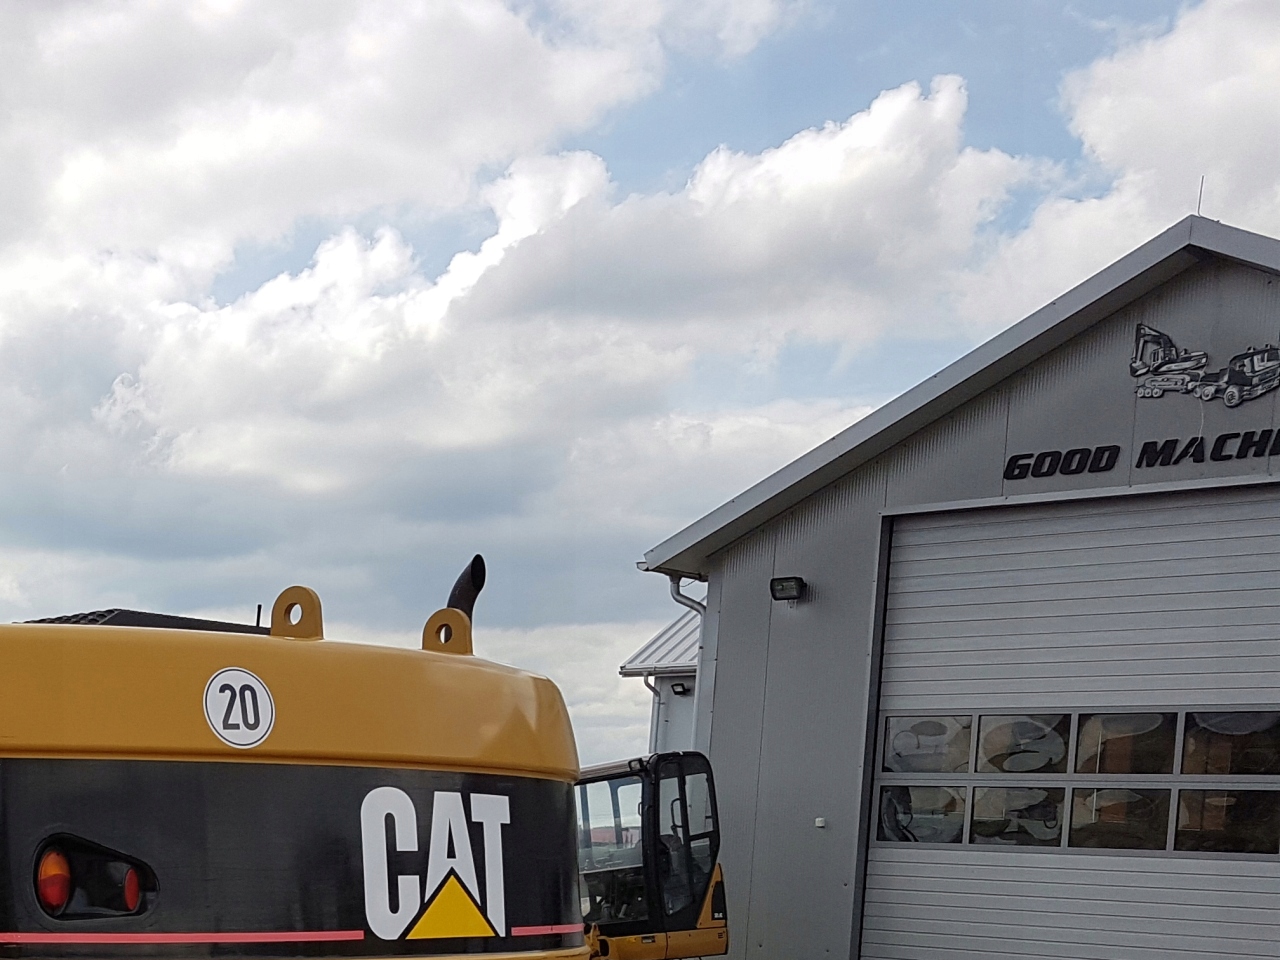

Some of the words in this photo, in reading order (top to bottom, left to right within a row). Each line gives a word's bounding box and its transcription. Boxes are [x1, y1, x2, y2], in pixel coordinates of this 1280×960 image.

[1003, 445, 1121, 480] GOOD
[218, 683, 261, 731] 20
[360, 786, 511, 941] CAT
